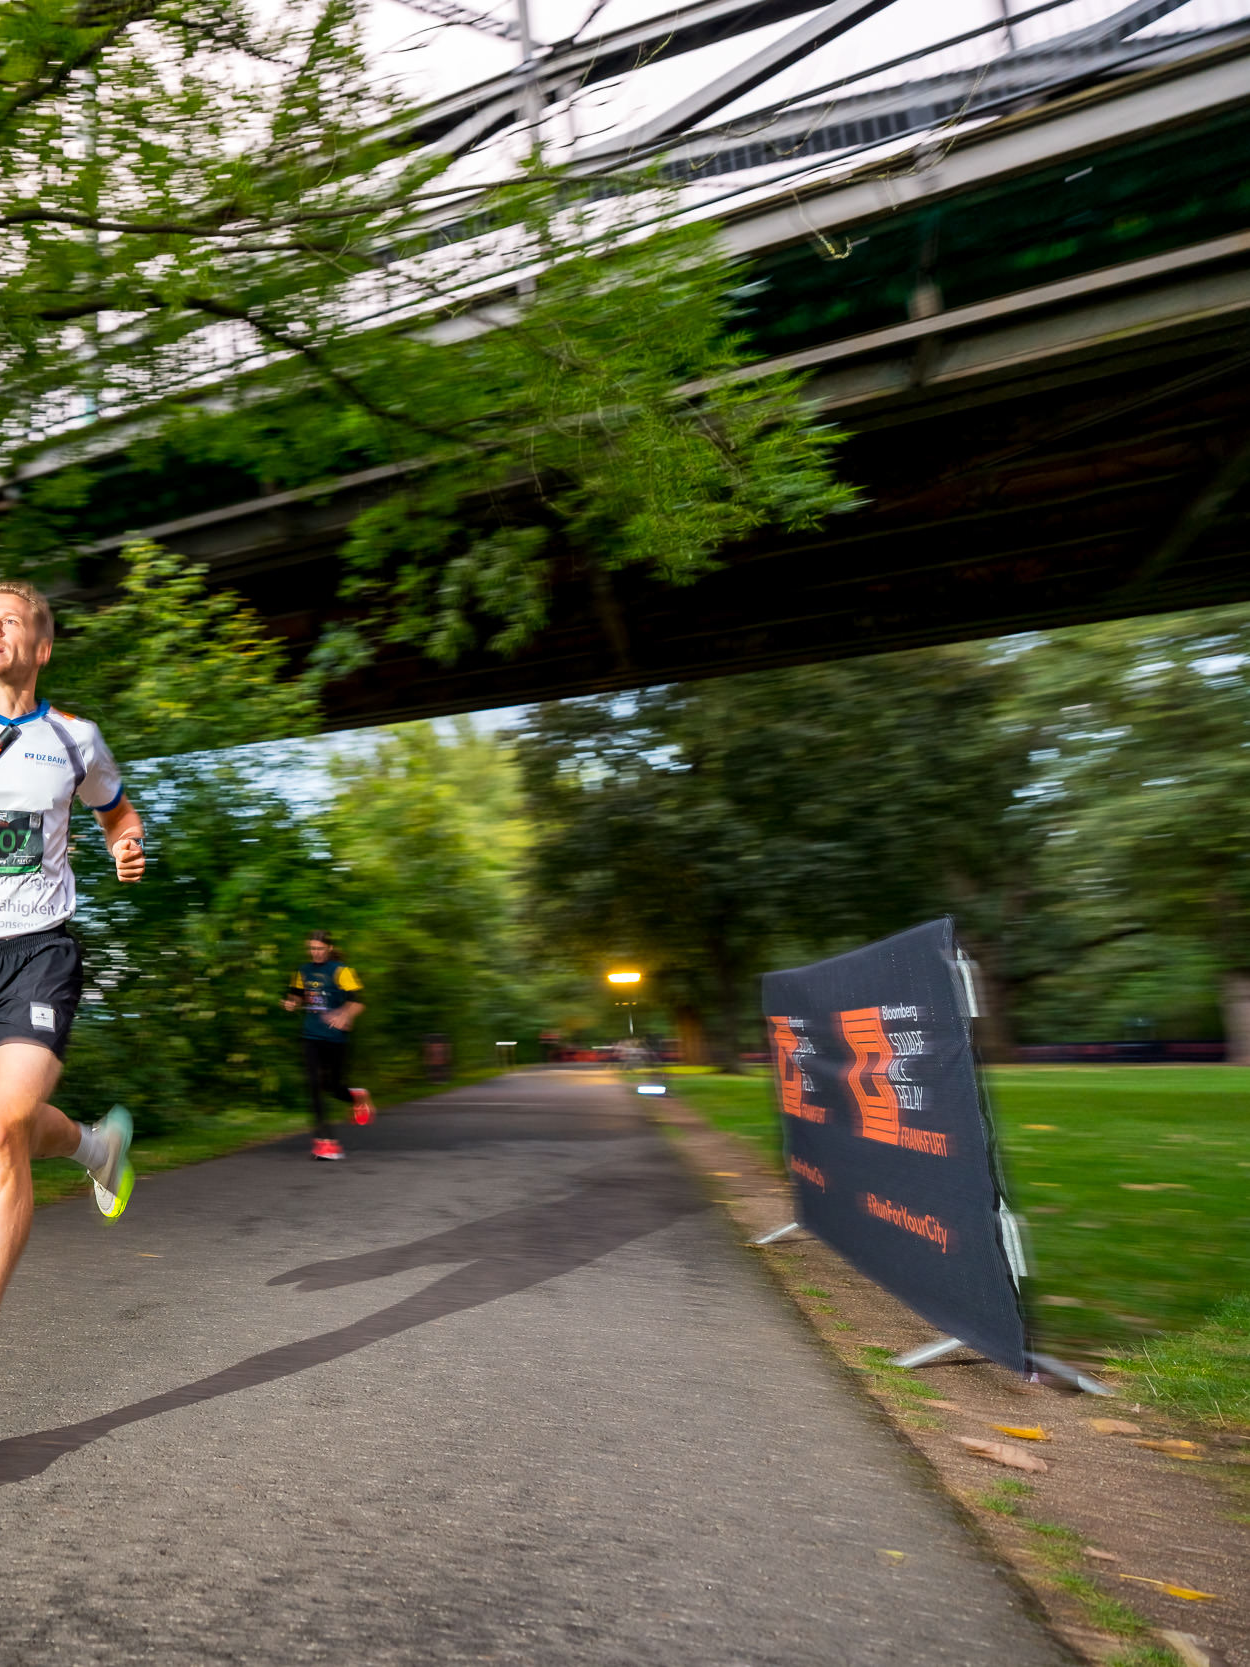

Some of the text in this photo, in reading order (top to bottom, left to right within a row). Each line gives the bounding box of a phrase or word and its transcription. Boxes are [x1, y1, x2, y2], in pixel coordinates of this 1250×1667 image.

[36, 753, 47, 761] DZ
[47, 755, 67, 765] BANK
[881, 1002, 918, 1022] Bloomberg
[889, 1030, 925, 1056] SQUARE
[894, 1084, 923, 1111] RELAY
[900, 1126, 948, 1158] FRANKFURT
[867, 1192, 948, 1254] #RunForYourCity
